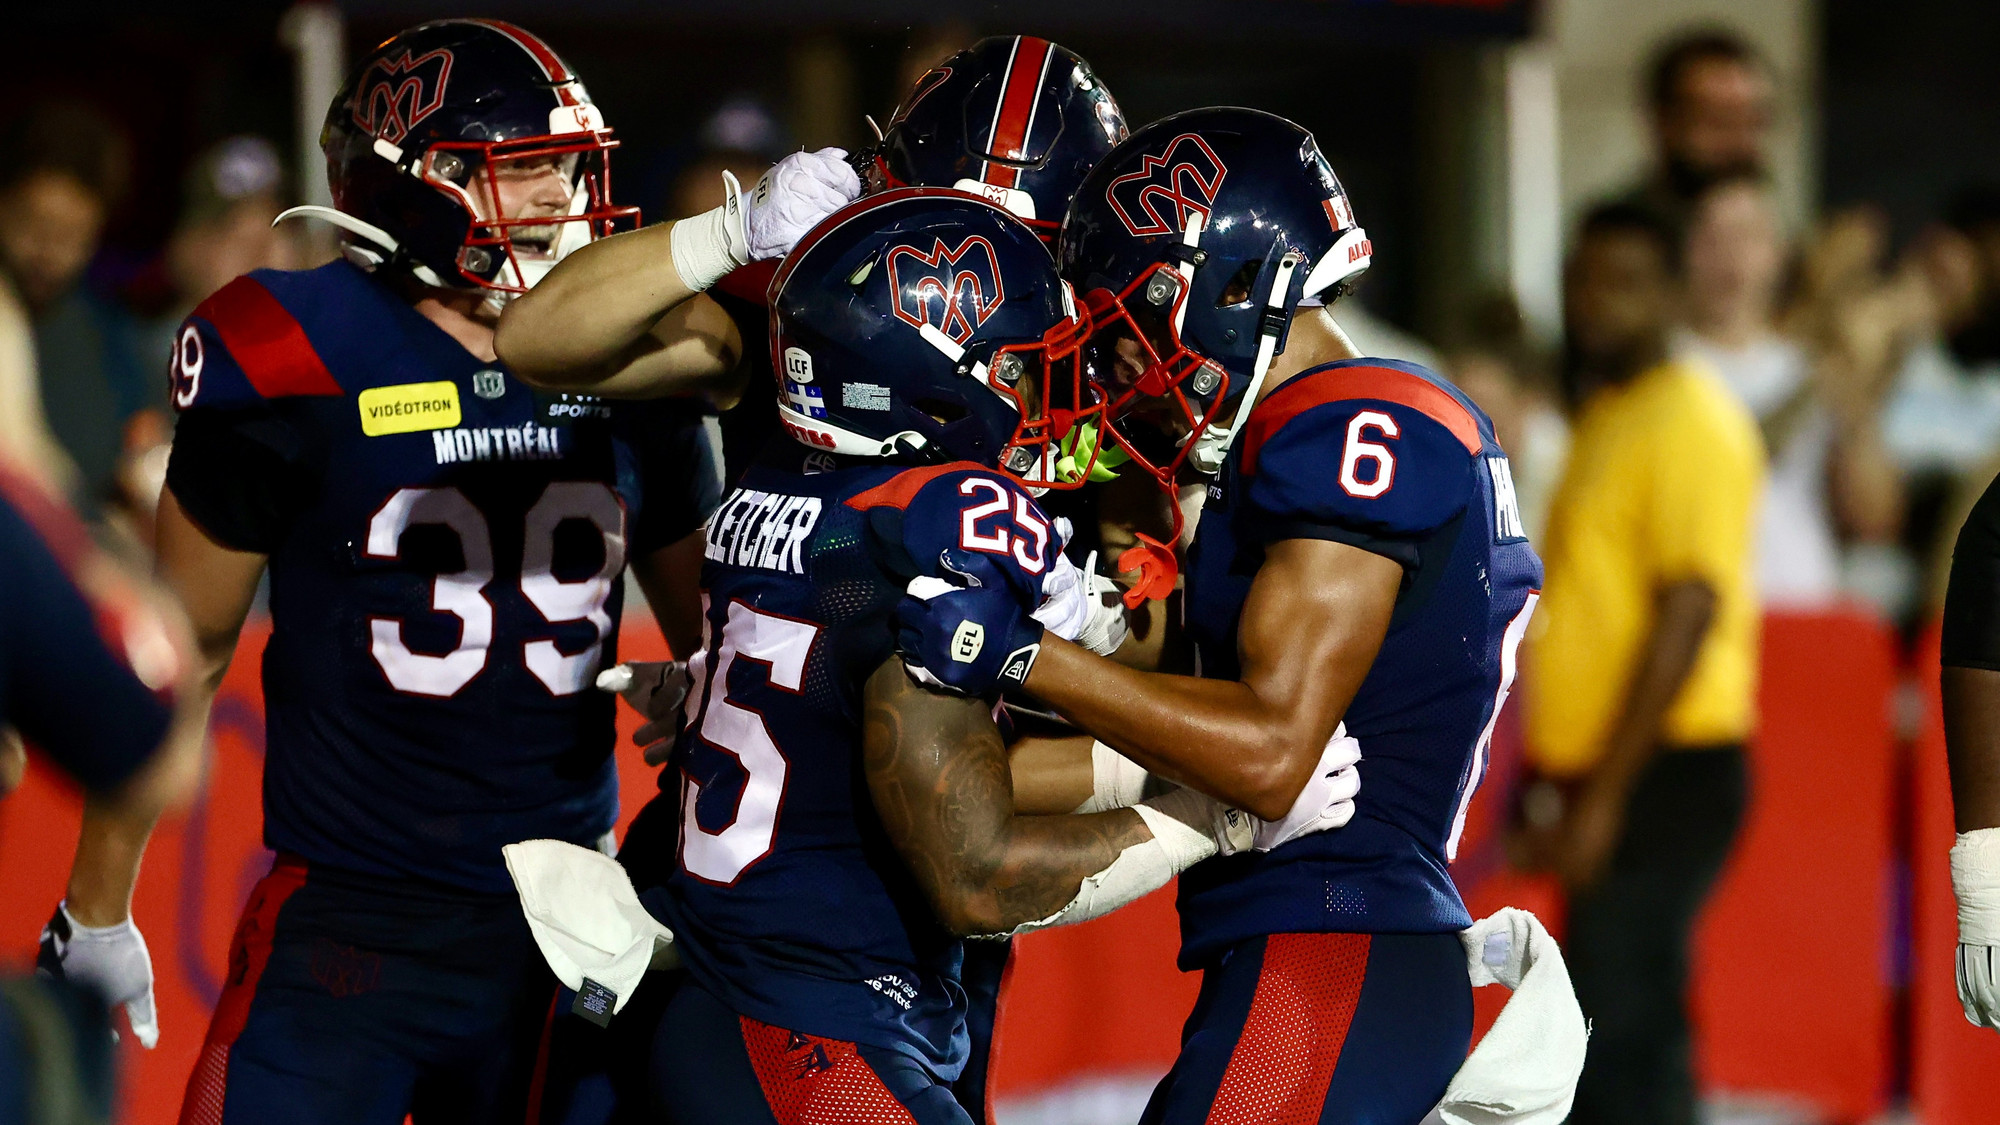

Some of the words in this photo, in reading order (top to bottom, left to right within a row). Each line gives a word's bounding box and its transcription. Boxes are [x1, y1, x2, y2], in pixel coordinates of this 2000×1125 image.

[788, 356, 809, 376] LCF
[368, 394, 453, 419] VIDÉOTRON
[548, 402, 613, 420] SPORTS
[432, 420, 565, 465] MONTRÉAL
[1337, 408, 1401, 500] 6
[704, 487, 822, 575] LETCHER
[957, 475, 1051, 577] 25
[361, 480, 626, 697] 39
[959, 629, 979, 657] CFL
